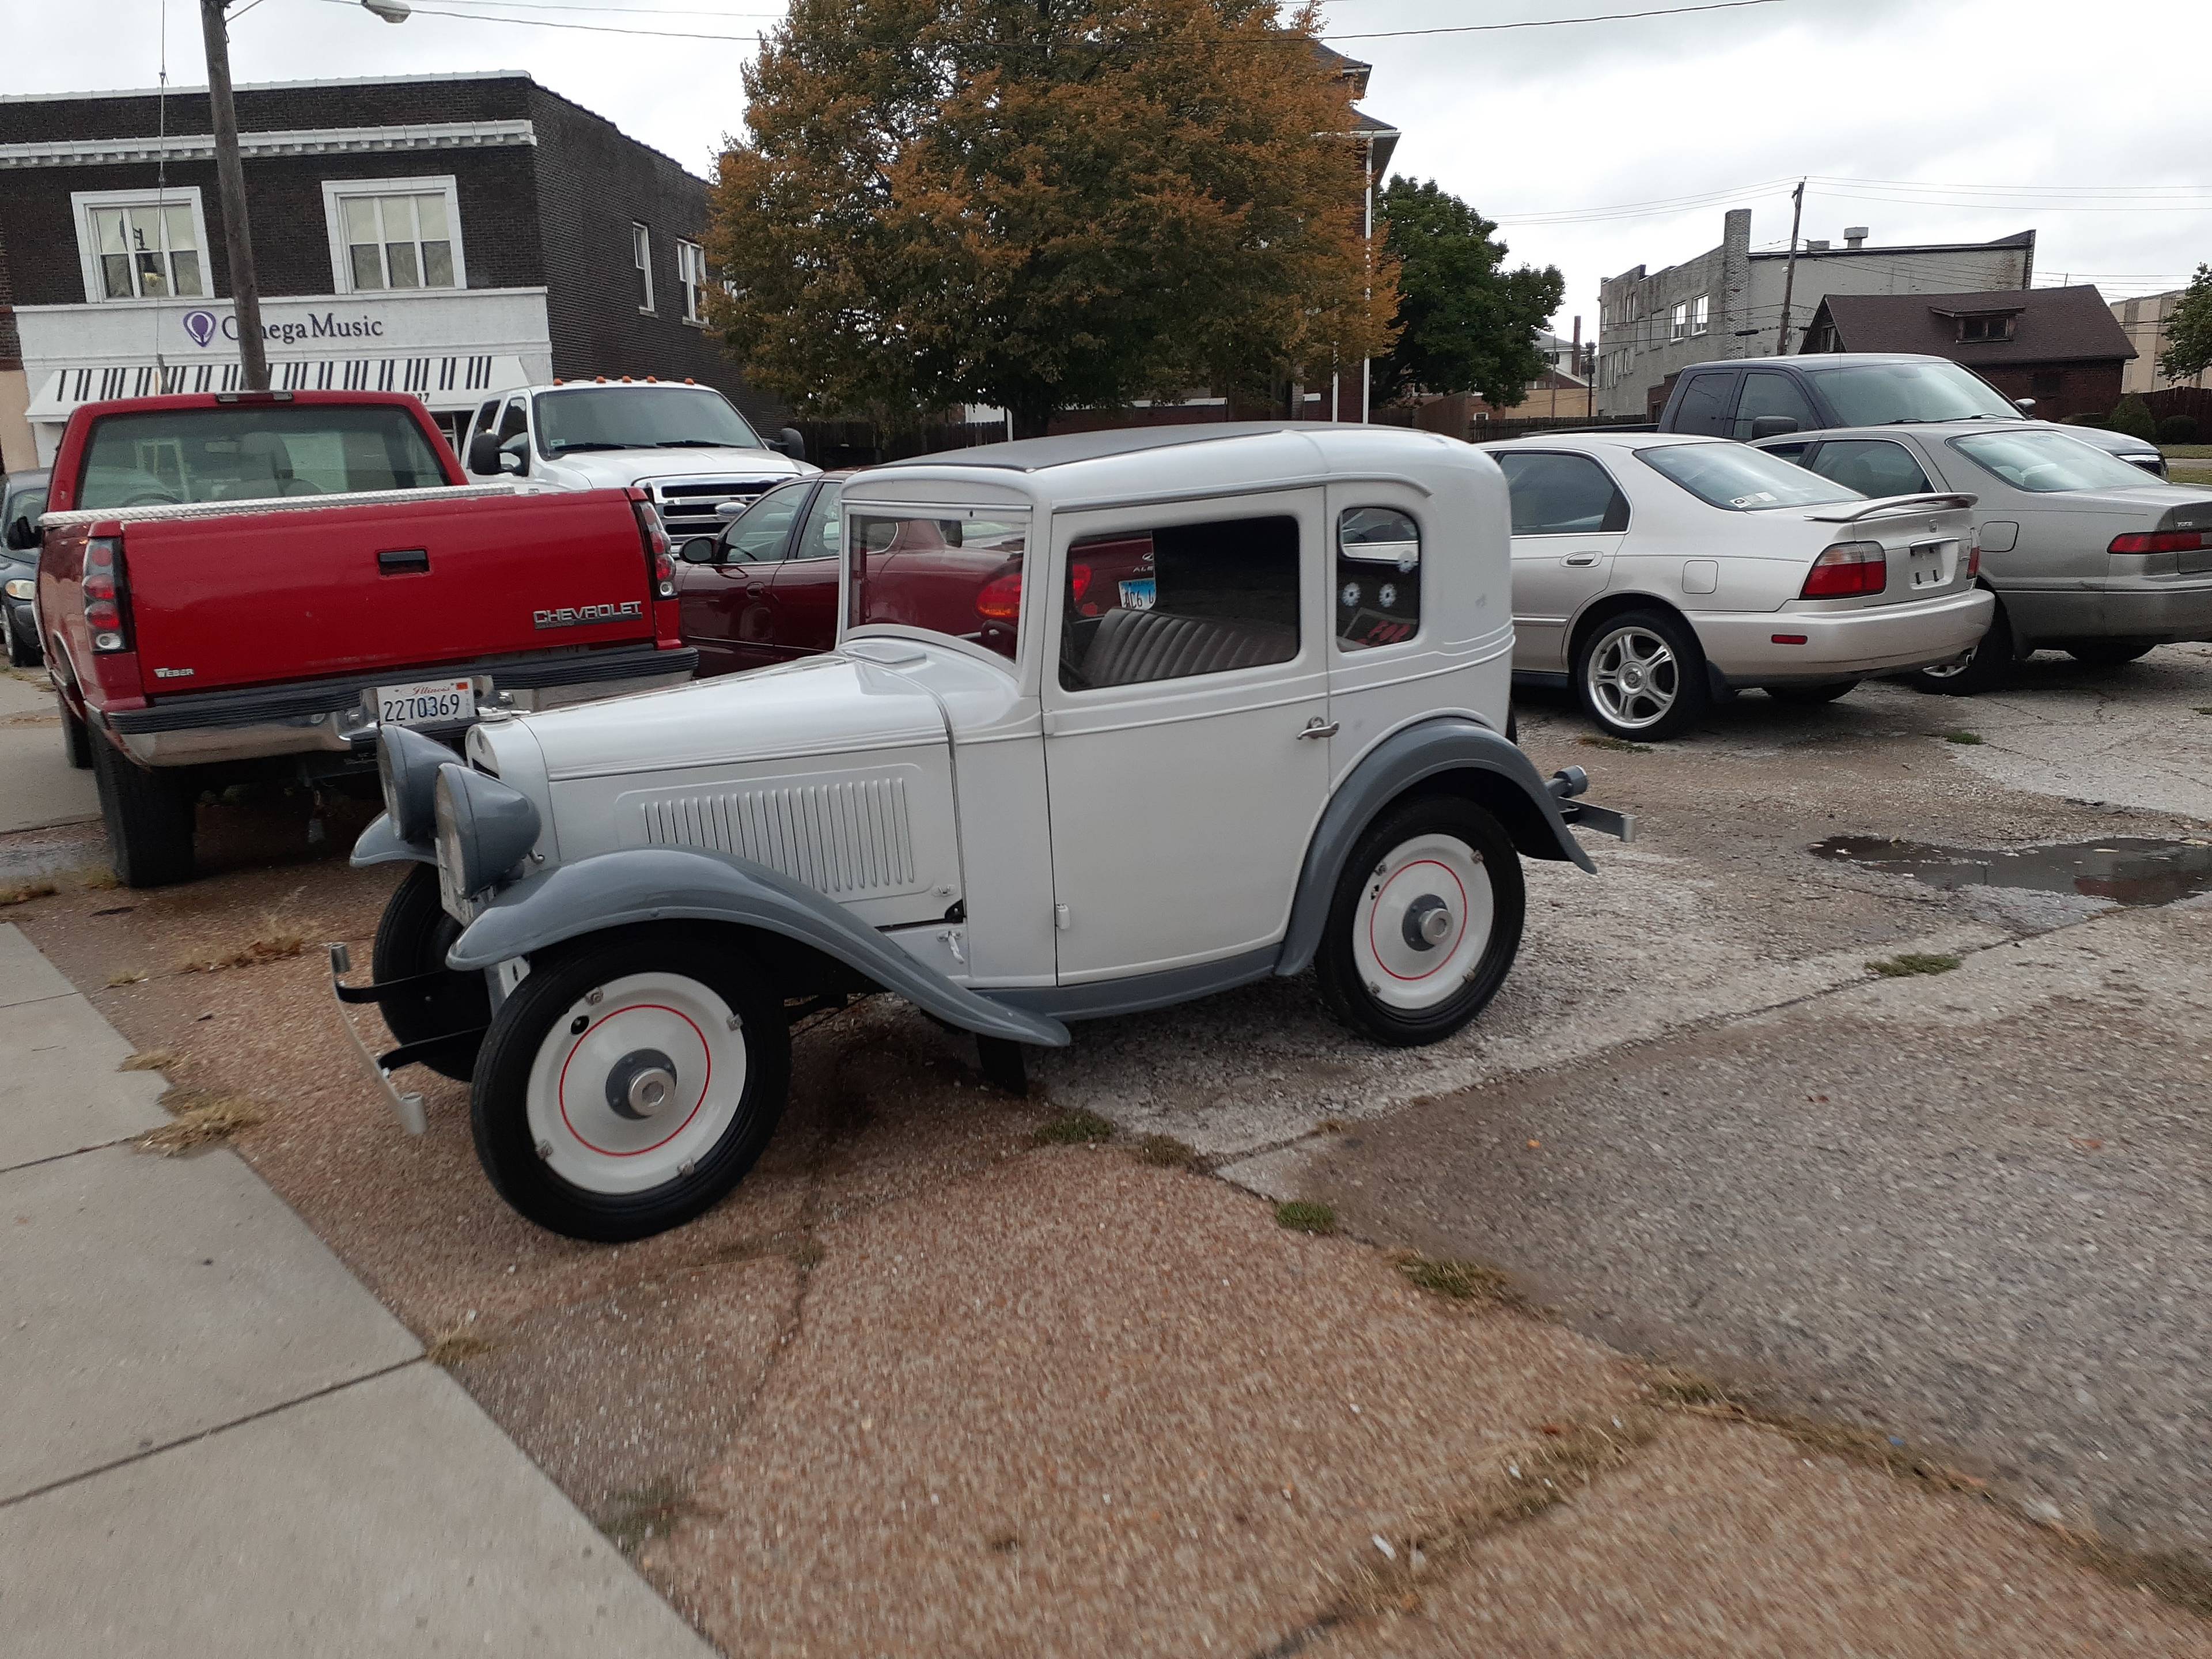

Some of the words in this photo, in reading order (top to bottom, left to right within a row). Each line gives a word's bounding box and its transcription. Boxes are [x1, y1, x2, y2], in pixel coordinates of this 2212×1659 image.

[308, 312, 383, 337] Music
[533, 601, 642, 623] CHEVROLET
[408, 684, 451, 696] Illinois
[384, 694, 460, 722] 2270369
